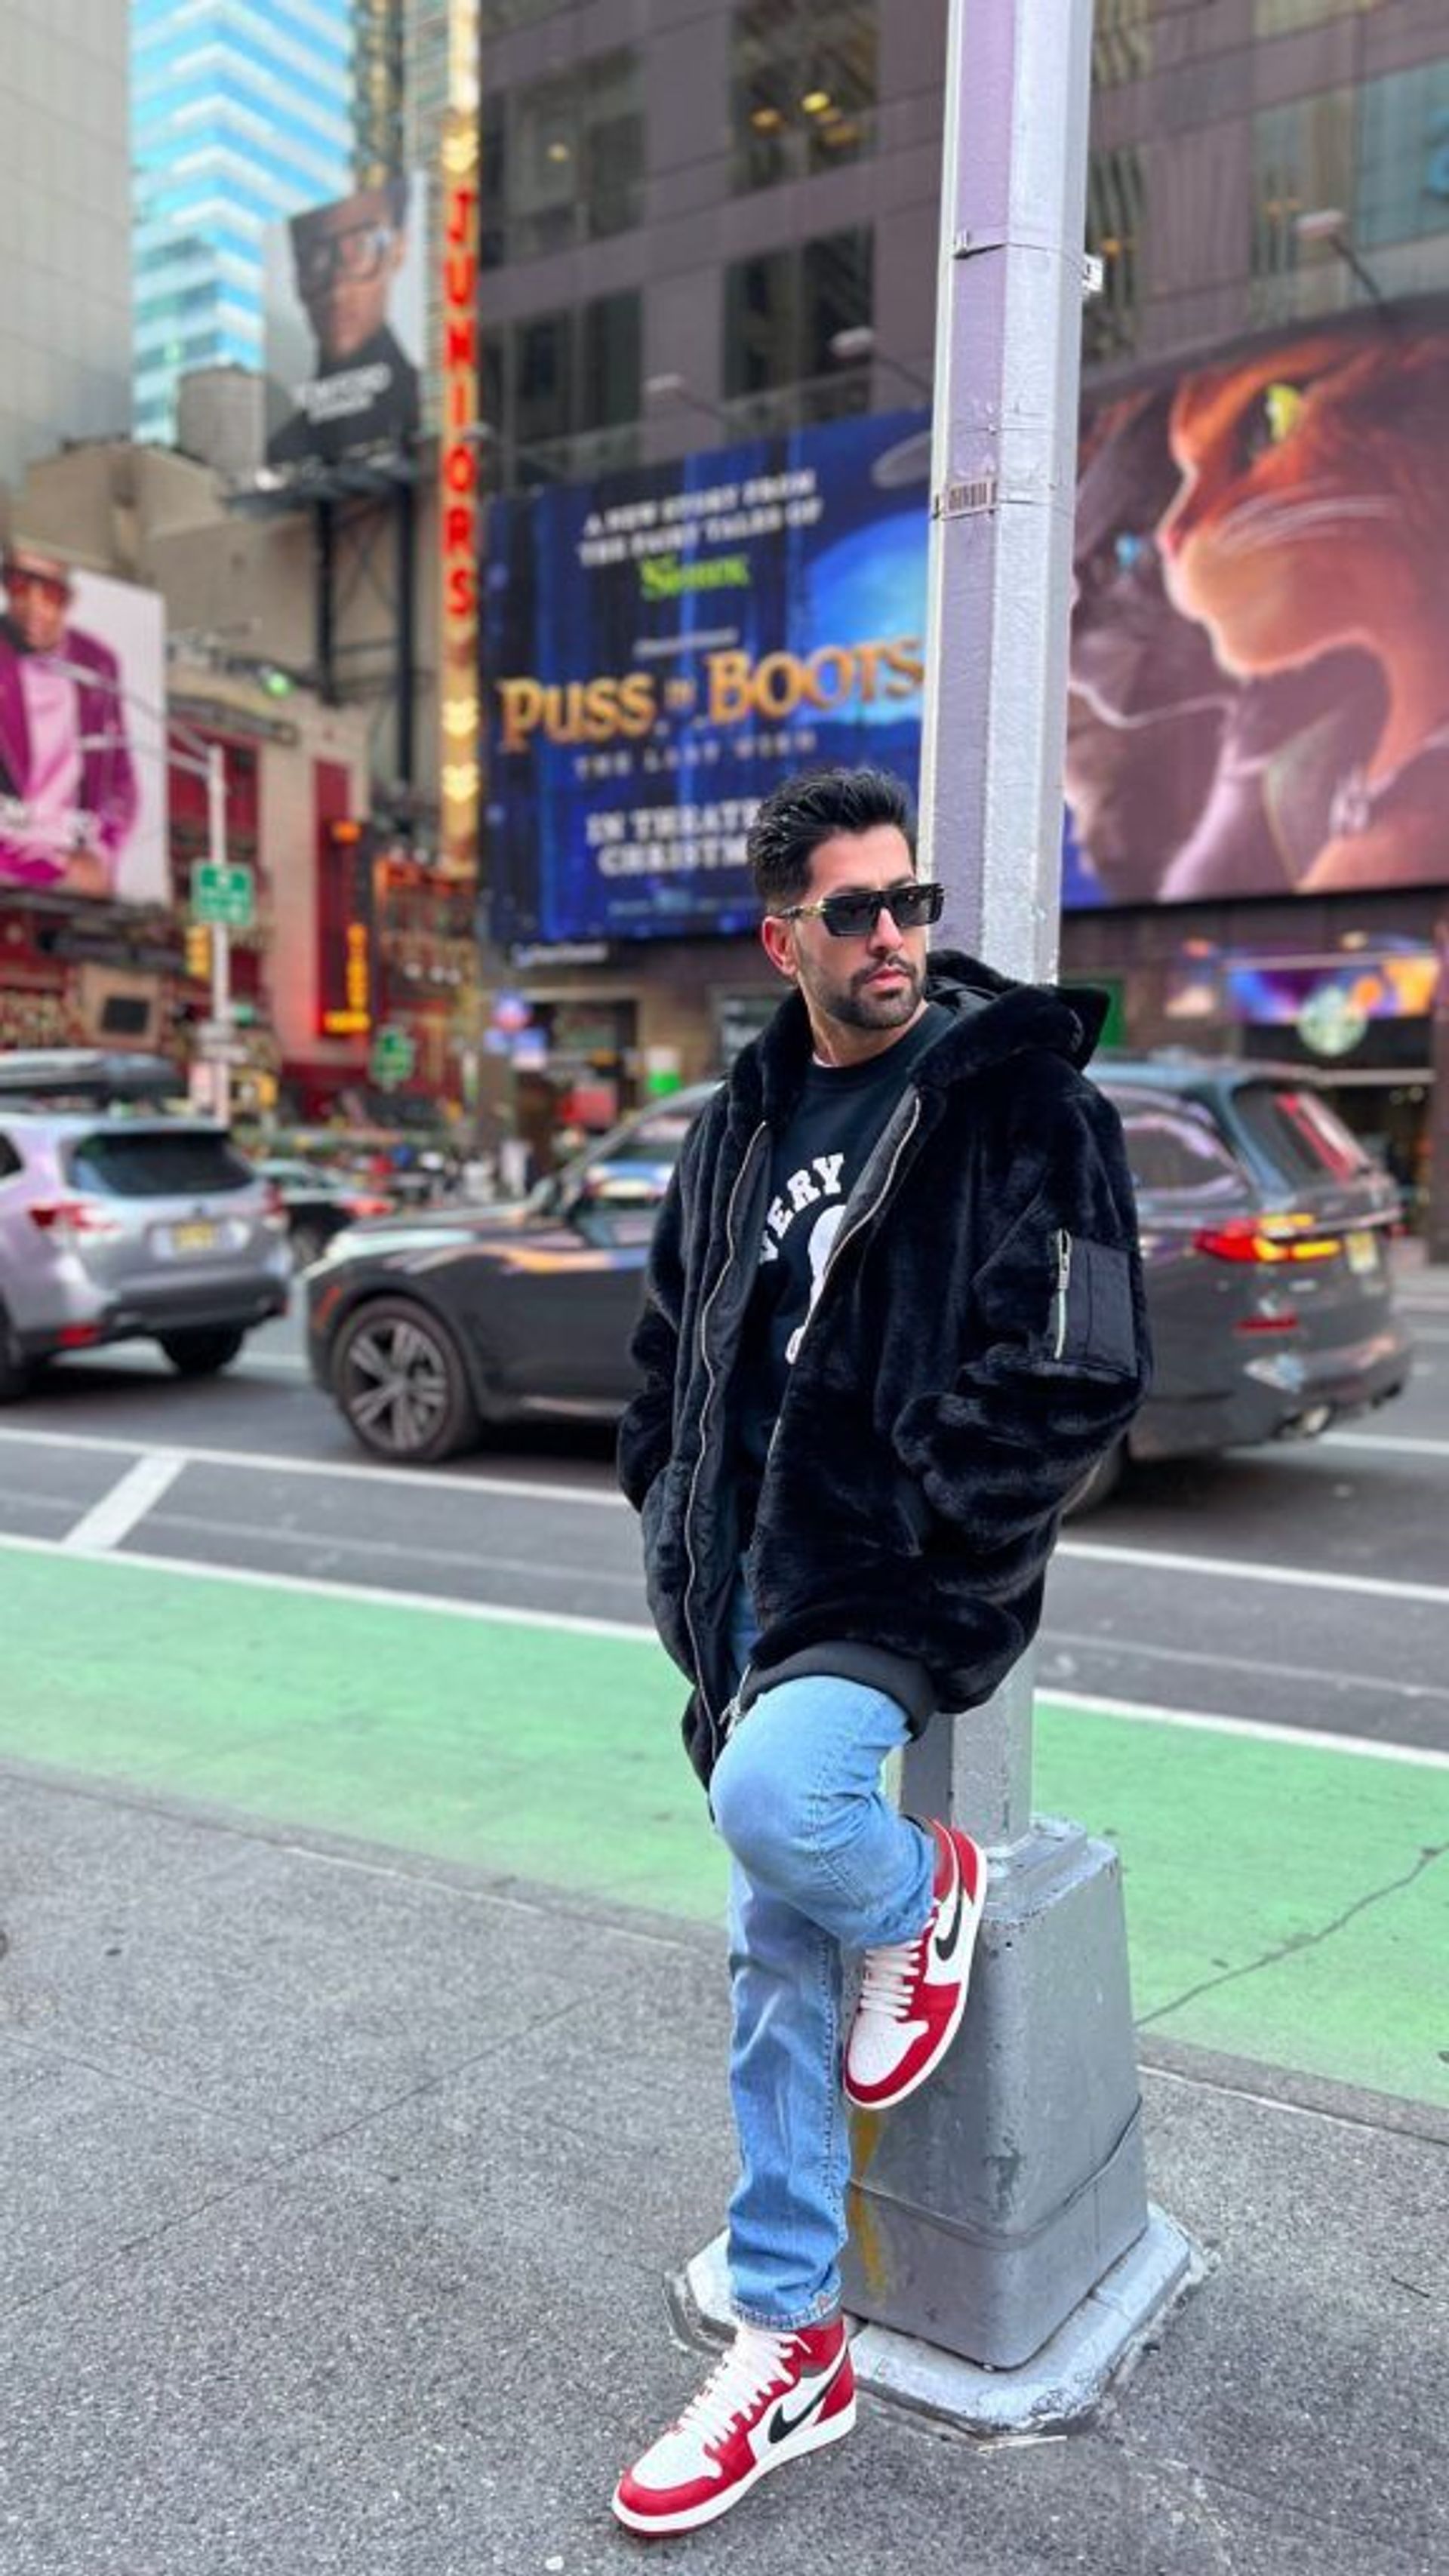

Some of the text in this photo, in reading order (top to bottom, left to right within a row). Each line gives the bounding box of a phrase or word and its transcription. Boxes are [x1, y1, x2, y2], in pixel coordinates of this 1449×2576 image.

[445, 191, 475, 617] JUNIORS
[497, 672, 657, 753] PUSS
[704, 637, 924, 725] BOOTS
